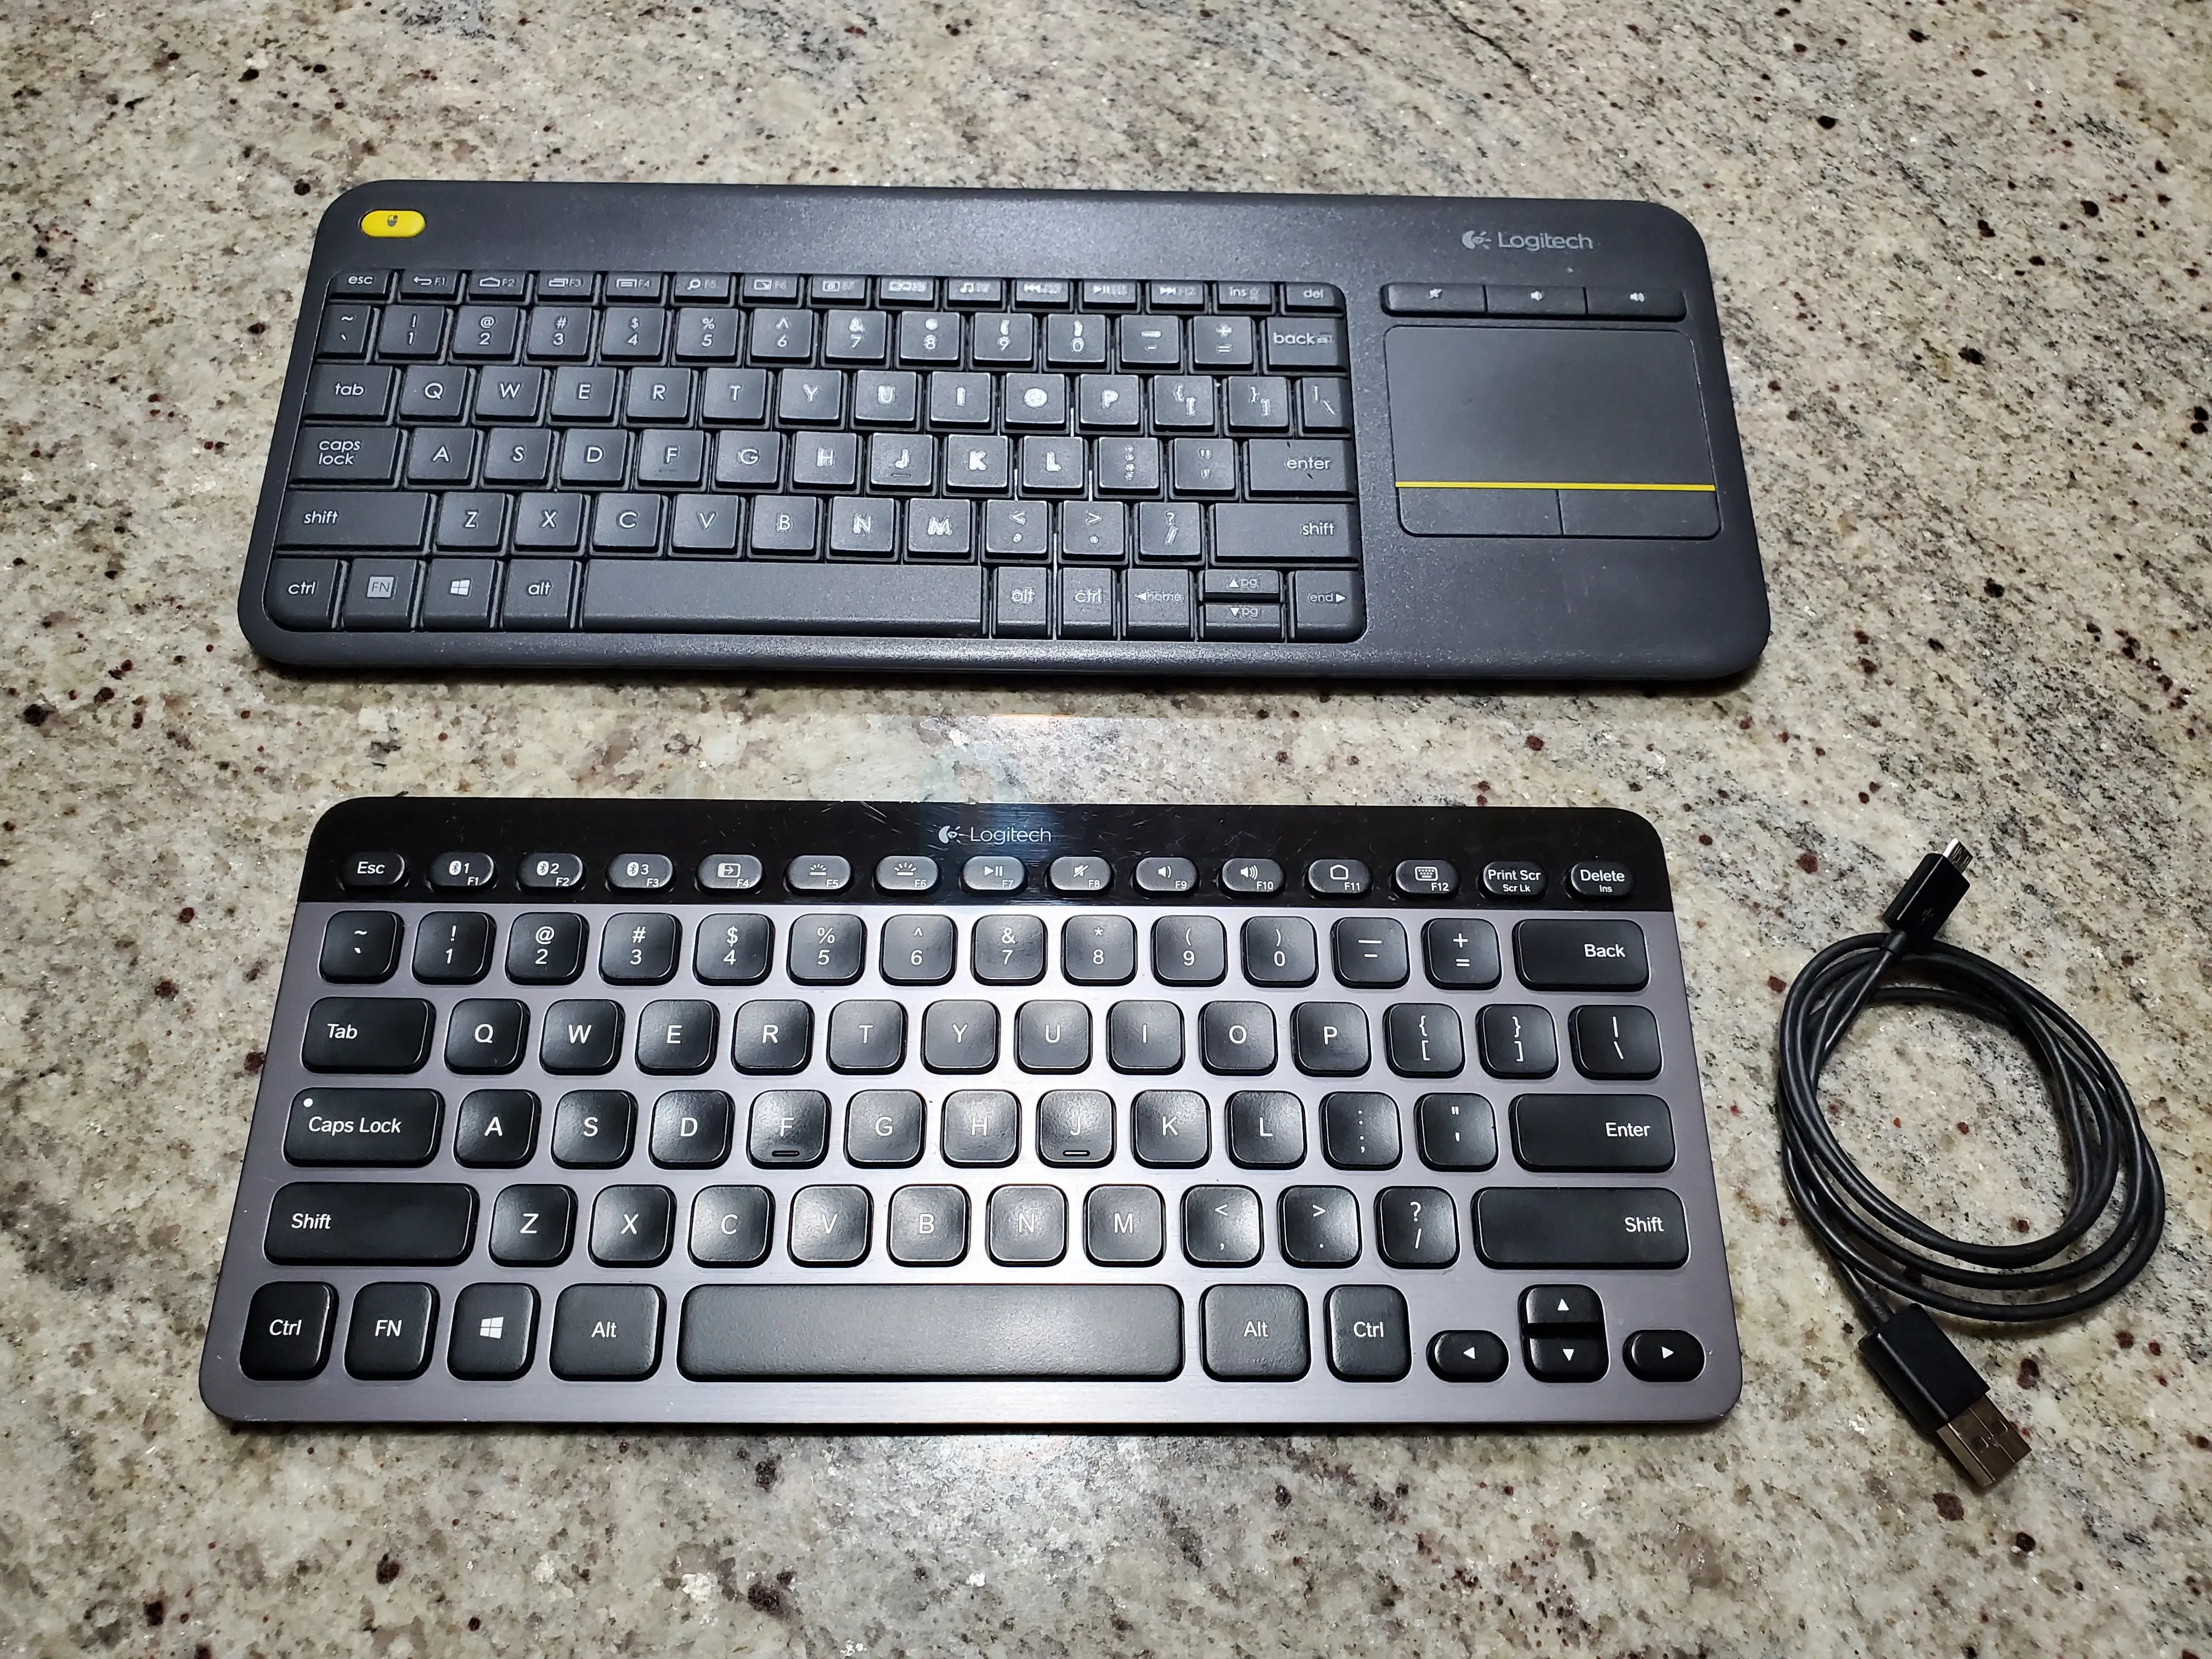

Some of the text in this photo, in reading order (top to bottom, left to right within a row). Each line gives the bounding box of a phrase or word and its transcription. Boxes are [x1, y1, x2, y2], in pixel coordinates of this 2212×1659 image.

[1498, 232, 1593, 251] Logitech
[348, 276, 373, 285] esc
[434, 277, 445, 286] F1
[502, 278, 515, 287] F2
[569, 278, 582, 287] F3
[638, 279, 650, 288] F4
[1229, 286, 1247, 299] ins
[1304, 288, 1324, 299] del
[480, 317, 495, 329] @
[556, 316, 567, 329] #
[631, 317, 639, 330] $
[702, 318, 715, 330] %
[408, 332, 414, 345] 1
[479, 332, 490, 345] 2
[553, 332, 564, 346] 3
[628, 333, 638, 346] 4
[701, 334, 713, 347] 5
[777, 334, 787, 347] 6
[850, 334, 862, 348] 7
[923, 334, 936, 350] 8
[999, 336, 1011, 351] 9
[1272, 332, 1317, 345] back
[335, 382, 364, 396] tab
[425, 382, 443, 399] Q
[500, 383, 521, 398] W
[578, 383, 591, 399] E
[653, 385, 666, 400] R
[730, 385, 741, 401] T
[803, 384, 819, 402] Y
[877, 385, 896, 404] U
[1101, 391, 1119, 409] P
[319, 441, 361, 453] caps
[432, 446, 449, 462] A
[513, 446, 524, 462] S
[586, 447, 603, 462] D
[665, 447, 678, 463] F
[318, 452, 354, 465] lock
[738, 448, 759, 465] G
[816, 447, 836, 467] H
[969, 450, 988, 471] K
[1046, 452, 1062, 472] L
[1286, 456, 1331, 471] enter
[304, 510, 338, 524] shift
[465, 511, 478, 528] Z
[542, 510, 557, 528] X
[619, 511, 637, 528] C
[699, 512, 715, 530] V
[776, 514, 793, 532] B
[853, 513, 871, 534] N
[927, 516, 953, 536] M
[1302, 522, 1335, 535] shift
[288, 581, 316, 595] ctrl
[371, 582, 390, 592] FN
[528, 581, 551, 595] alt
[1239, 578, 1260, 591] pg
[1012, 588, 1035, 604] alt
[1075, 588, 1102, 605] ctrl
[1310, 592, 1334, 602] end
[1239, 605, 1259, 619] pg
[970, 826, 1051, 845] Logitech
[357, 861, 385, 874] Esc
[464, 862, 470, 874] 1
[550, 863, 560, 874] 2
[640, 864, 649, 875] 3
[1488, 869, 1541, 881] Print Scr
[1580, 869, 1625, 882] Delete
[467, 876, 479, 886] F1
[555, 877, 570, 887] F2
[646, 878, 661, 888] F3
[735, 878, 751, 889] F4
[825, 879, 840, 889] F5
[913, 879, 929, 889] F6
[1000, 879, 1016, 889] F7
[1087, 879, 1102, 889] F8
[1173, 881, 1187, 891] F9
[1256, 881, 1274, 891] F10
[1344, 882, 1360, 891] F11
[1431, 882, 1449, 891] F12
[1503, 884, 1531, 893] Scr Lk
[1599, 884, 1613, 893] Ins
[450, 925, 456, 942] !
[535, 926, 555, 945] @
[632, 926, 646, 943] #
[726, 926, 738, 947] $
[817, 927, 835, 944] %
[1001, 927, 1016, 944] &
[445, 948, 453, 964] 1
[535, 949, 548, 964] 2
[630, 949, 642, 965] 3
[723, 949, 736, 966] 4
[817, 949, 830, 965] 5
[911, 950, 923, 965] 6
[1002, 949, 1013, 965] 7
[1093, 949, 1104, 964] 8
[1183, 950, 1195, 966] 9
[1584, 944, 1626, 957] Back
[1274, 951, 1285, 967] 0
[327, 1023, 358, 1039] Tab
[475, 1024, 494, 1043] Q
[568, 1024, 592, 1044] W
[666, 1025, 682, 1044] E
[762, 1024, 778, 1043] R
[859, 1025, 874, 1044] T
[952, 1024, 968, 1043] Y
[1045, 1024, 1060, 1043] U
[1142, 1024, 1147, 1043] I
[1229, 1025, 1247, 1044] O
[1323, 1026, 1338, 1045] P
[308, 1116, 402, 1136] Caps Lock
[484, 1116, 503, 1137] A
[583, 1116, 599, 1137] S
[680, 1117, 698, 1137] D
[780, 1116, 796, 1137] F
[875, 1116, 893, 1136] G
[972, 1116, 988, 1137] H
[1070, 1116, 1081, 1136] J
[1162, 1116, 1180, 1136] K
[1259, 1116, 1273, 1137] L
[1605, 1122, 1651, 1137] Enter
[1410, 1201, 1421, 1222] ?
[291, 1212, 332, 1229] Shift
[520, 1213, 539, 1234] Z
[621, 1214, 639, 1234] X
[721, 1214, 738, 1235] C
[822, 1212, 838, 1234] V
[919, 1214, 935, 1234] B
[1017, 1211, 1037, 1235] N
[1114, 1212, 1133, 1234] M
[1624, 1216, 1664, 1233] Shift
[269, 1319, 302, 1336] Ctrl
[375, 1319, 402, 1337] FN
[591, 1321, 617, 1338] Alt
[1244, 1321, 1269, 1337] Alt
[1353, 1321, 1384, 1338] Ctrl
